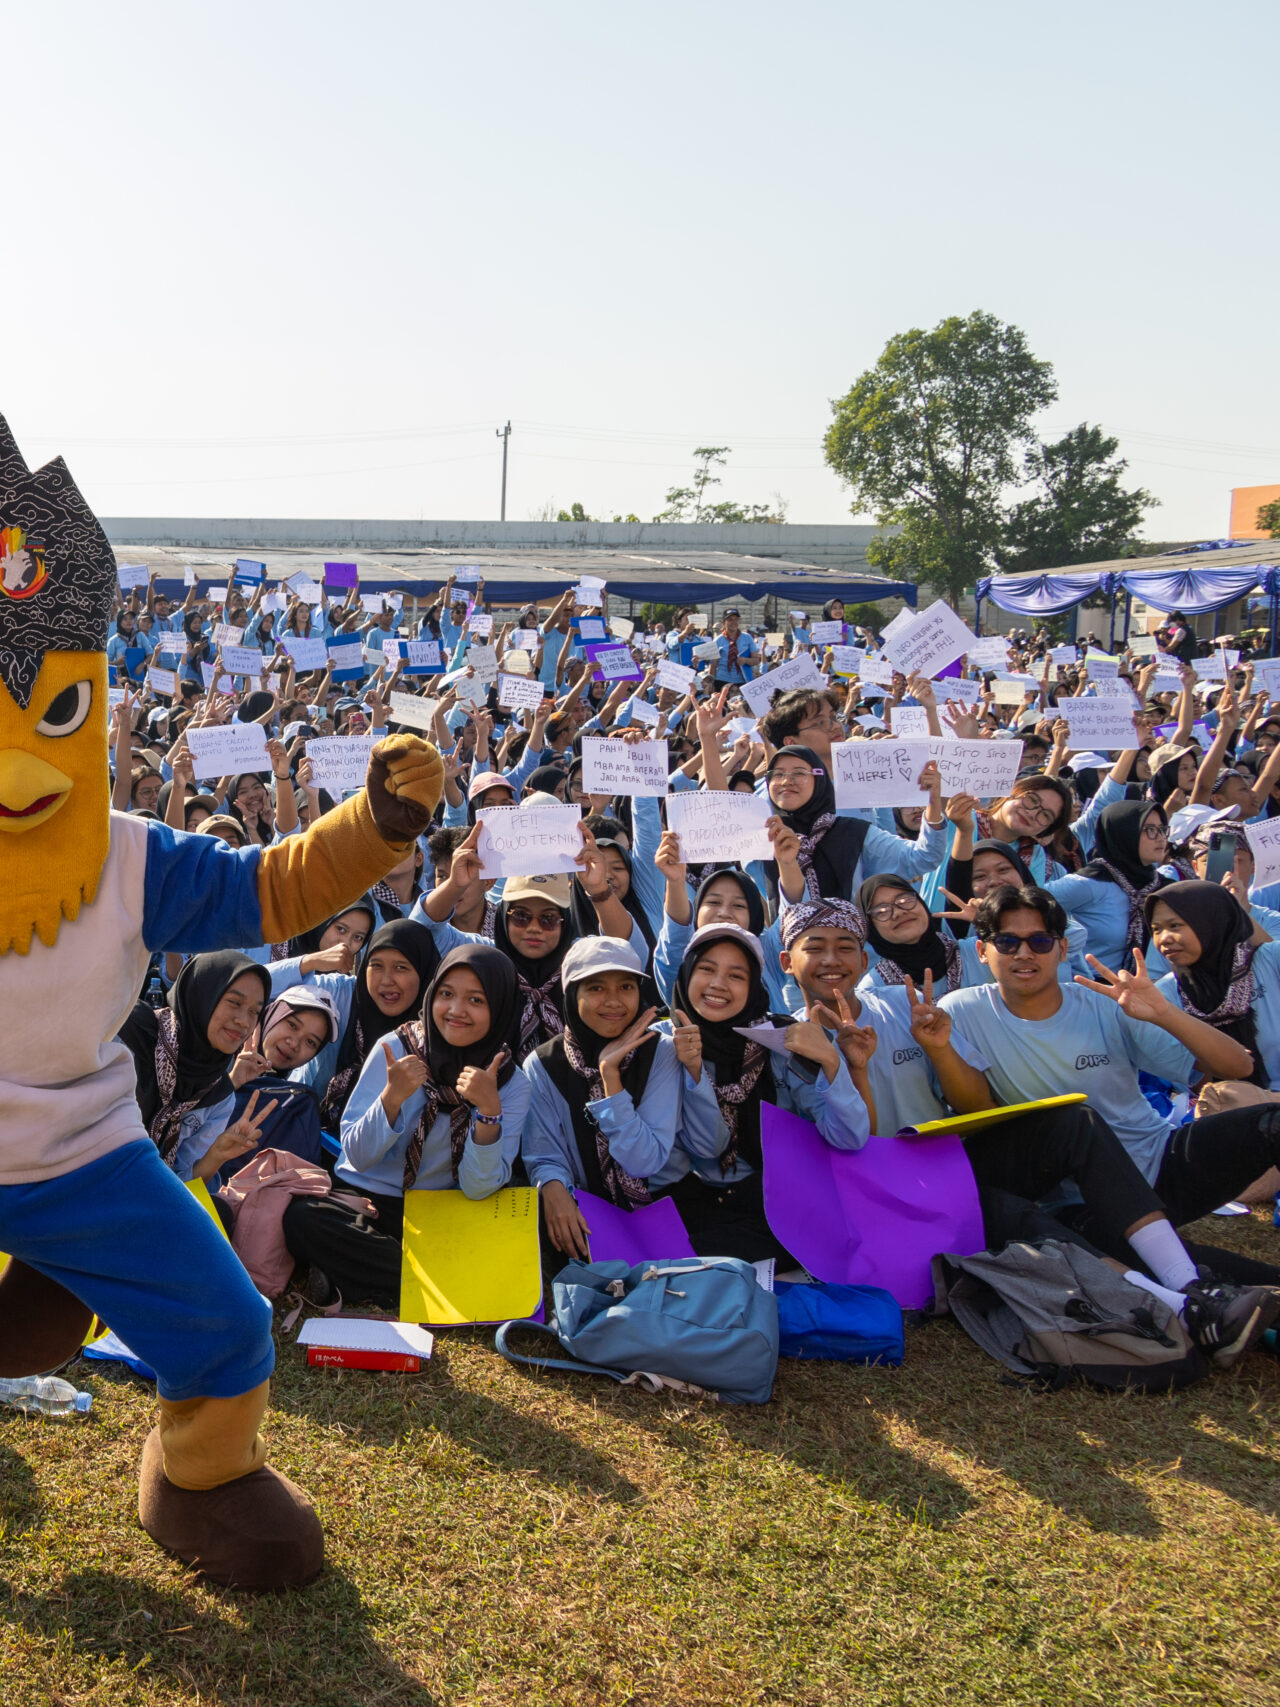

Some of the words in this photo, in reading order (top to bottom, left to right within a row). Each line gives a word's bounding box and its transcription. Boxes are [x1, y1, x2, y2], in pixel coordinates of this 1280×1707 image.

[749, 677, 775, 698] SEKALI
[780, 664, 801, 681] KEDIP
[896, 722, 925, 736] DEMI
[1072, 727, 1101, 737] MASUK
[312, 745, 330, 756] YANG
[320, 760, 344, 771] TAHUN
[344, 759, 366, 769] UDAH
[600, 773, 618, 783] JADI
[858, 769, 894, 783] HERE!
[511, 813, 538, 830] PE!!
[486, 837, 528, 853] COWO
[529, 833, 578, 847] TEKNIK
